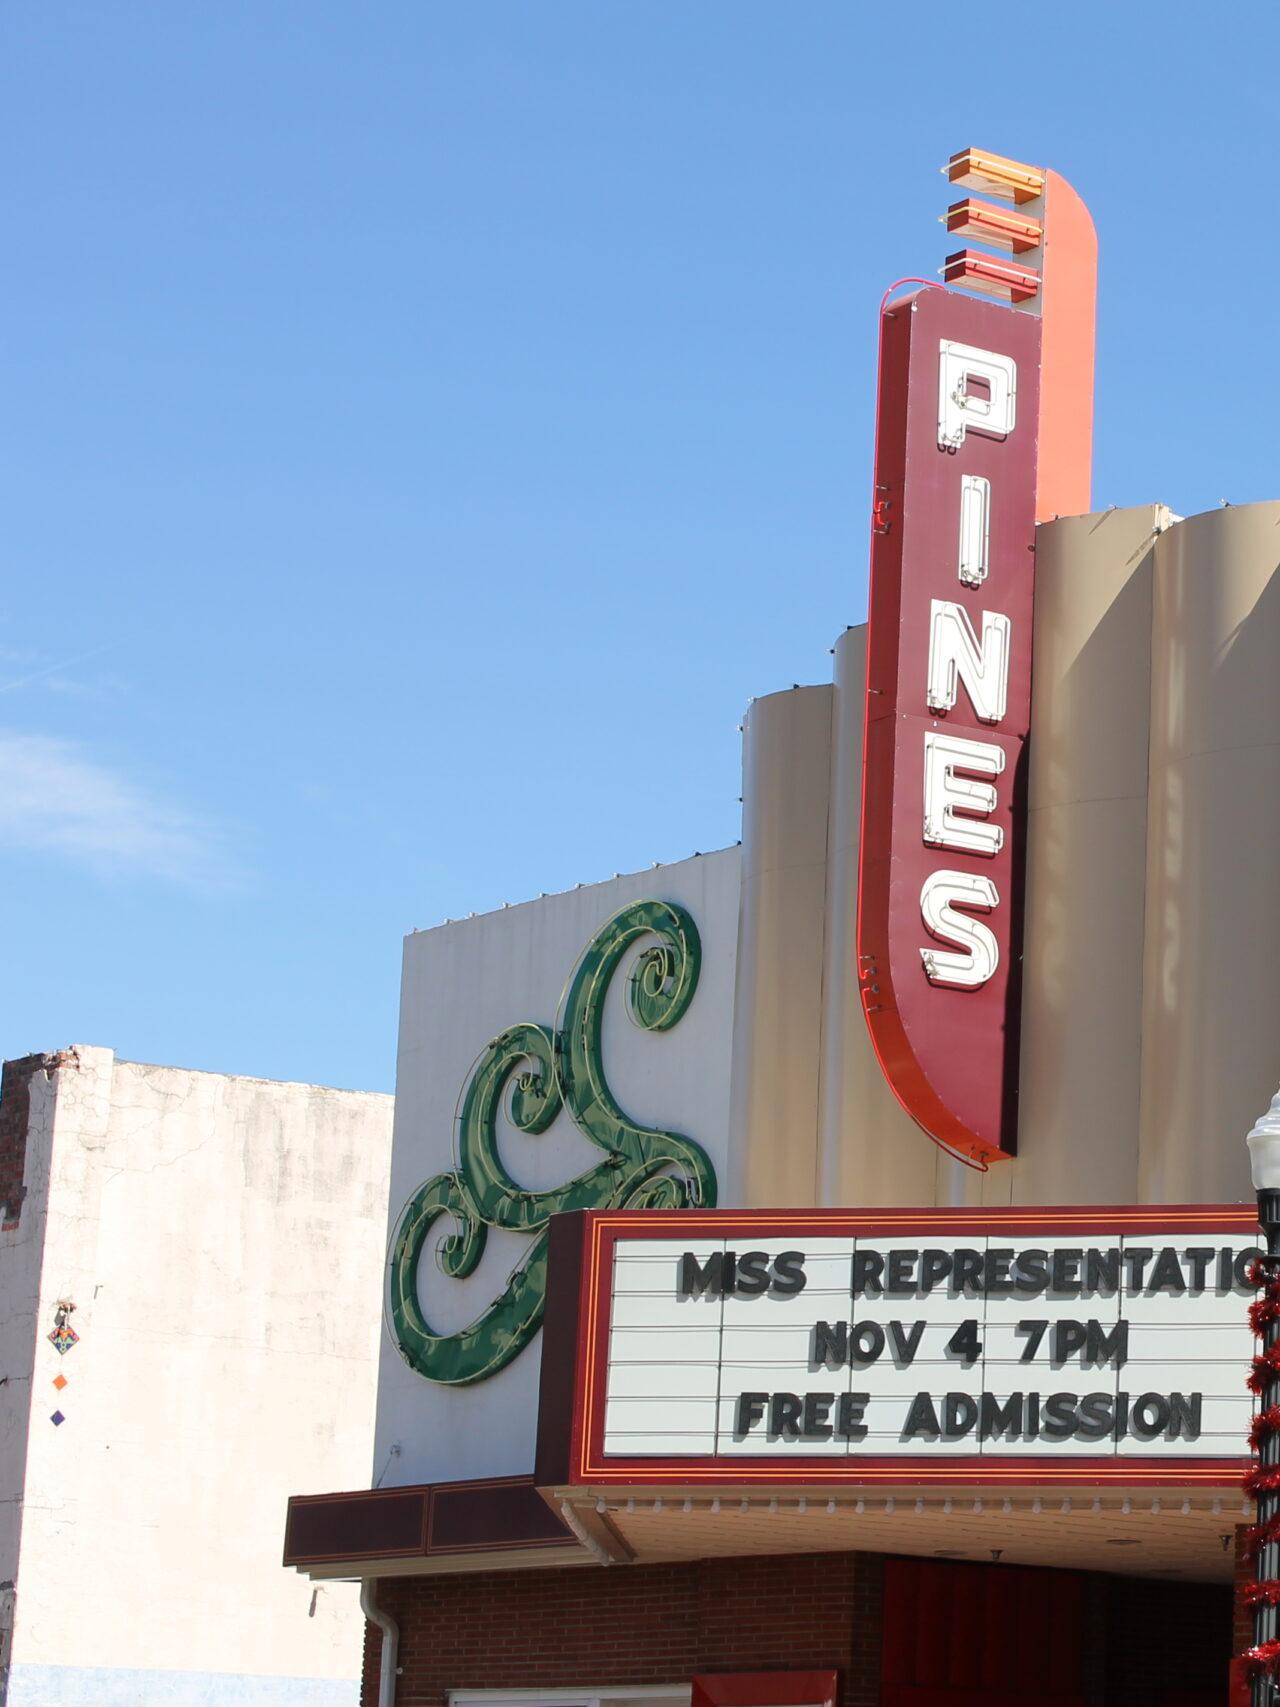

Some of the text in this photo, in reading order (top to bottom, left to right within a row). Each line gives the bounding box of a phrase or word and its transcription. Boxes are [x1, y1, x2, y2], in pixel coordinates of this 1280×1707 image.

[920, 337, 1018, 989] PINES
[682, 1251, 807, 1294] MISS
[814, 1319, 1129, 1364] NOV 4 7PM
[737, 1391, 1202, 1436] FREE ADMISSION
